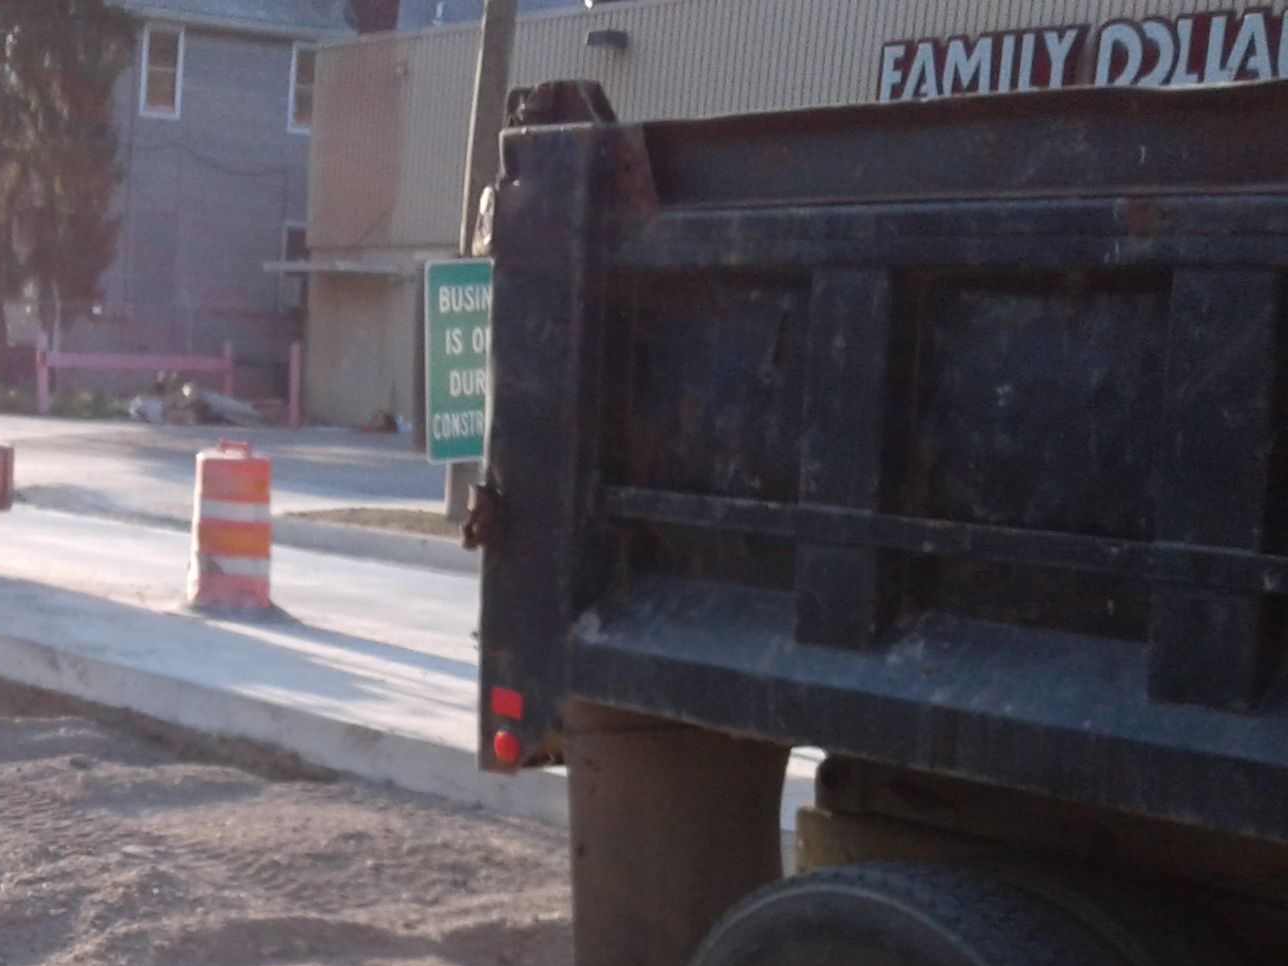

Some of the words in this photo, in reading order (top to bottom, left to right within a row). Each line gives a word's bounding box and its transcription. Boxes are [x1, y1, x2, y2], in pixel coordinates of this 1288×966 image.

[880, 28, 1081, 101] FAMILY
[439, 286, 491, 313] BUSIN
[445, 328, 462, 355] IS
[450, 369, 488, 397] DUR
[433, 411, 484, 440] CONSTR
